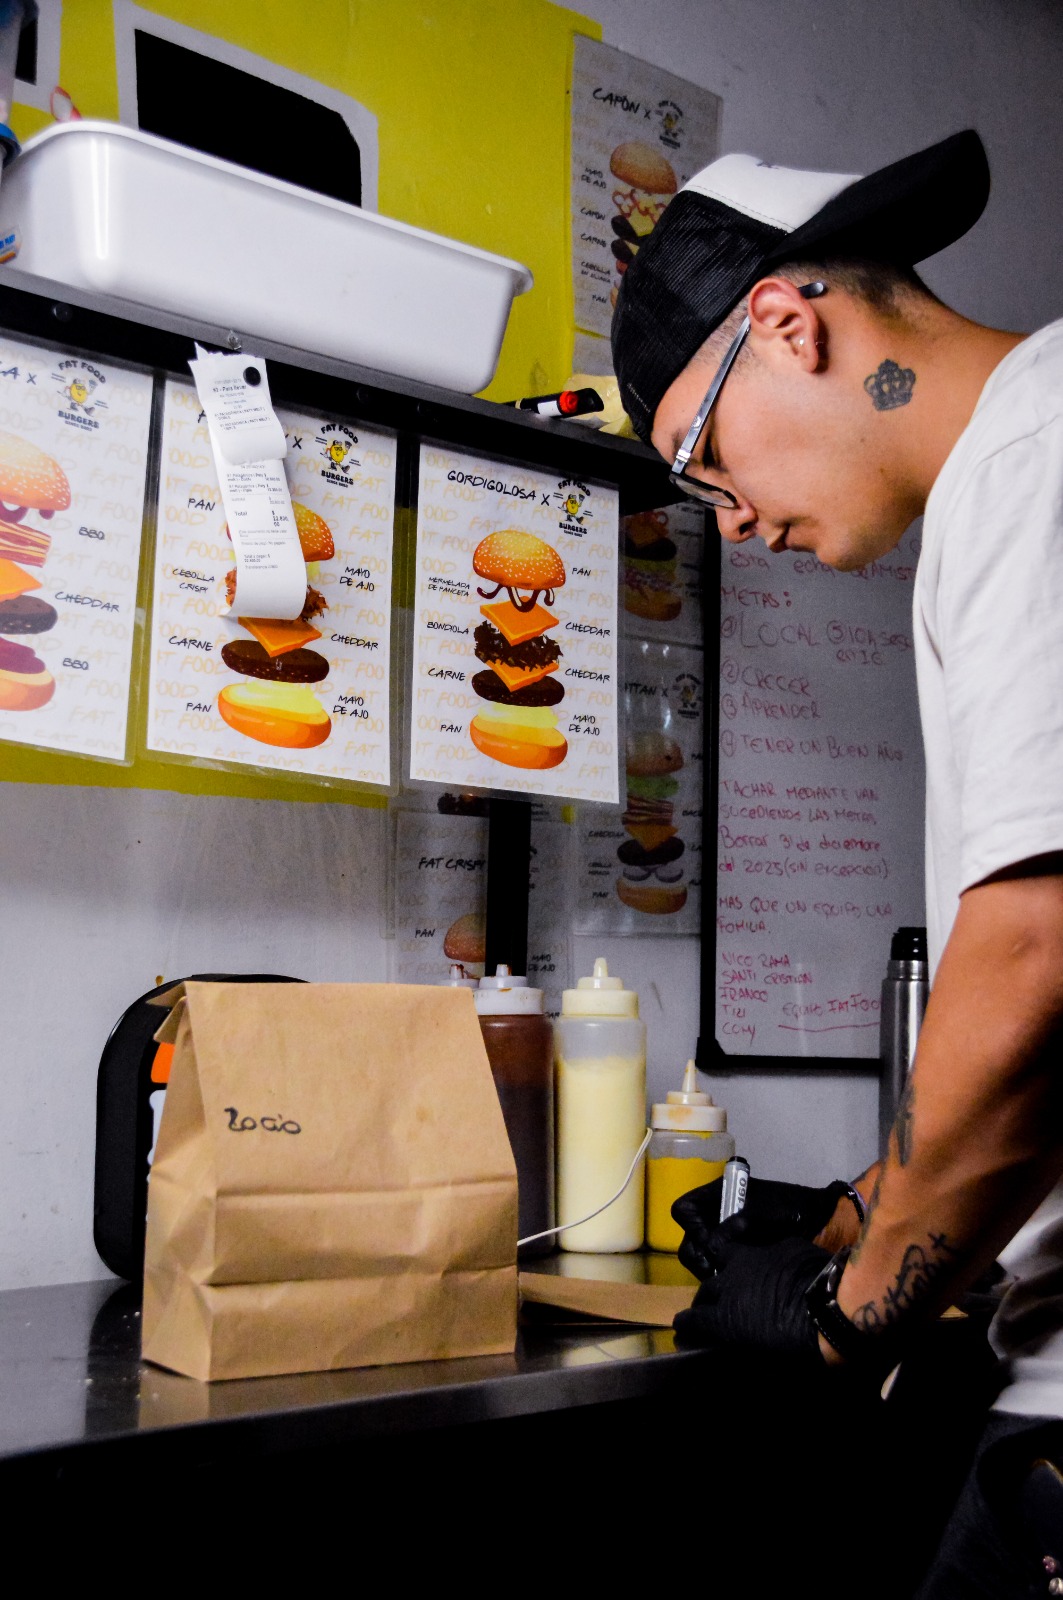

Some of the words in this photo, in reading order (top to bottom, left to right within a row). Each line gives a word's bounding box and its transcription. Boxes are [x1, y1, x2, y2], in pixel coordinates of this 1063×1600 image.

[58, 360, 79, 371] FAT
[80, 361, 107, 384] FOOD
[58, 410, 100, 430] BURGERS
[320, 423, 337, 435] FAT
[338, 424, 360, 445] FOOD
[320, 470, 355, 486] BURGERS
[446, 470, 537, 501] GORDIGOLOSA
[557, 480, 572, 490] FAT
[572, 481, 592, 497] FOOD
[187, 497, 216, 512] PAN
[79, 526, 105, 541] BBQ
[558, 521, 588, 535] BURGERS
[171, 567, 215, 583] CEBOLLA
[344, 566, 371, 579] MAYO
[571, 567, 592, 577] PAN
[339, 576, 354, 587] DE
[355, 580, 375, 592] AJO
[427, 583, 438, 591] DE
[438, 585, 470, 597] PANCETA
[428, 576, 471, 590] MERMELADA
[54, 591, 120, 612] CHEDDAR
[426, 621, 470, 635] BONDIOLA
[565, 621, 611, 638] CHEDDAR
[740, 610, 822, 649] LOCAL
[168, 635, 214, 652] CARNE
[330, 633, 379, 650] CHEDDAR
[62, 657, 89, 671] BBQ
[427, 667, 467, 682] CARNE
[564, 667, 611, 683] CHEDDAR
[741, 666, 812, 697] CRECER
[185, 702, 213, 714] PAN
[337, 695, 365, 708] MAYO
[742, 691, 822, 720] APRENDER
[332, 704, 347, 715] DE
[349, 709, 369, 720] AJO
[573, 714, 596, 725] MAYO
[439, 723, 463, 734] PAN
[568, 723, 582, 733] DE
[582, 726, 600, 736] AJO
[740, 734, 795, 754] TENER
[799, 740, 823, 755] UN
[719, 780, 777, 799] TACHAR
[808, 807, 830, 824] LAS
[418, 857, 444, 870] FAT
[718, 896, 743, 911] MAS
[750, 896, 780, 914] QUE
[785, 900, 808, 913] UN
[414, 928, 436, 939] PAN
[738, 1177, 748, 1204] 160
